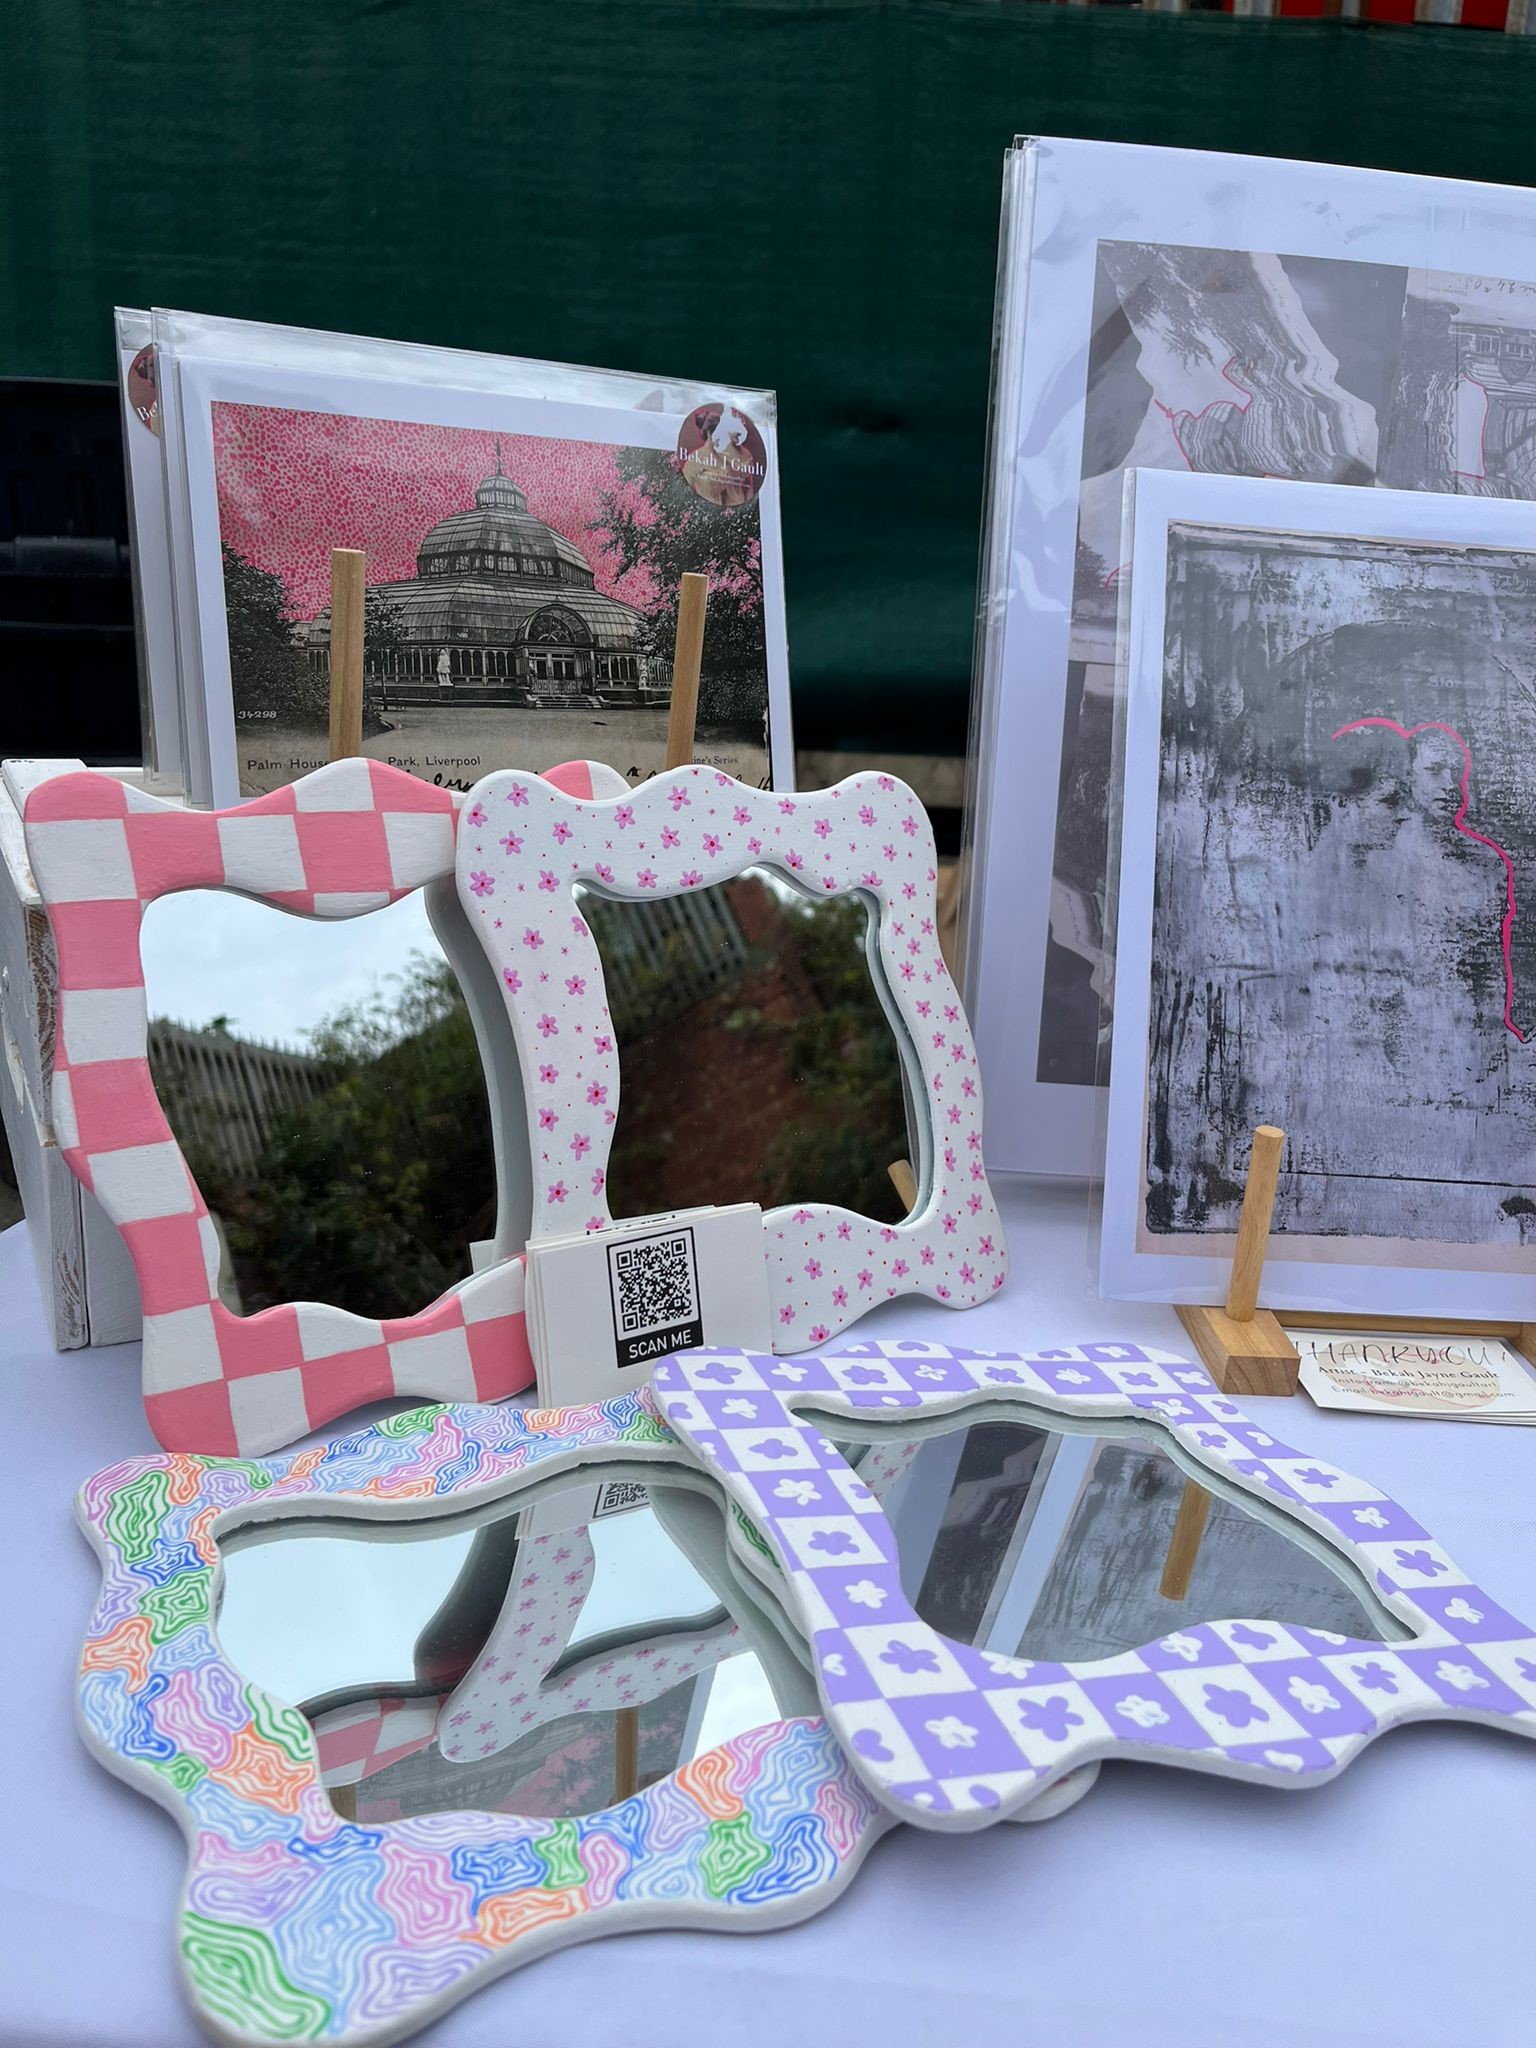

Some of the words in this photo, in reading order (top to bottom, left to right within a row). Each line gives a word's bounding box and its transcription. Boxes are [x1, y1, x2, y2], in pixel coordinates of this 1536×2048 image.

[679, 447, 717, 467] Bekah
[720, 456, 727, 470] J
[731, 458, 765, 476] Gault
[238, 711, 277, 719] 34298
[247, 759, 282, 770] Palm
[388, 756, 420, 767] Park,
[426, 756, 481, 768] Liverpool
[713, 755, 738, 765] Series
[629, 1336, 667, 1358] SCAN
[671, 1329, 692, 1347] ME
[1319, 1366, 1356, 1374] Artist
[1371, 1368, 1415, 1377] Bekah
[1417, 1370, 1456, 1379] Jayne
[1460, 1370, 1500, 1378] Gault
